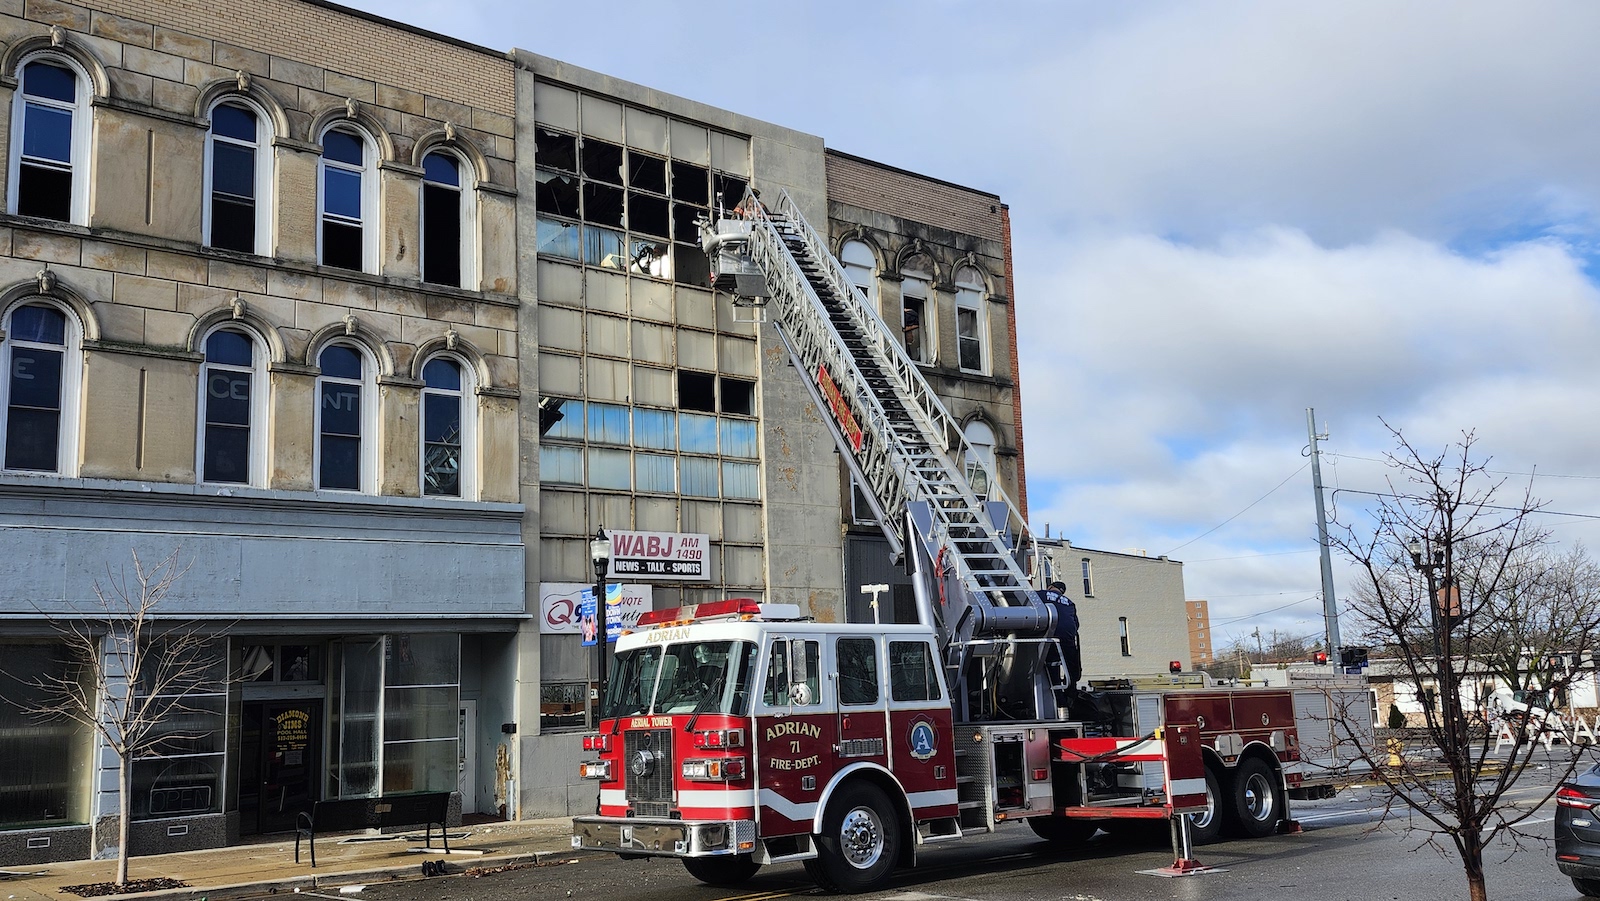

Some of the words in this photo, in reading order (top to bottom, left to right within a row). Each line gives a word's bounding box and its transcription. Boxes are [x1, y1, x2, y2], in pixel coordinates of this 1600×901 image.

[613, 534, 673, 558] WABJ
[680, 538, 699, 548] AM
[676, 549, 702, 560] 1490
[615, 561, 639, 572] NEWS
[646, 561, 665, 573] TALK
[672, 562, 701, 573] SPORTS
[645, 627, 691, 644] ADRIAN
[276, 710, 309, 723] DIAMOND
[631, 717, 650, 728] AERIAL
[651, 716, 673, 727] TOWER
[283, 720, 302, 729] JIMS
[766, 721, 821, 741] ADRIAN
[789, 740, 801, 753] 71
[770, 754, 821, 770] FIRE-DEPT.
[152, 789, 208, 811] OPEN
